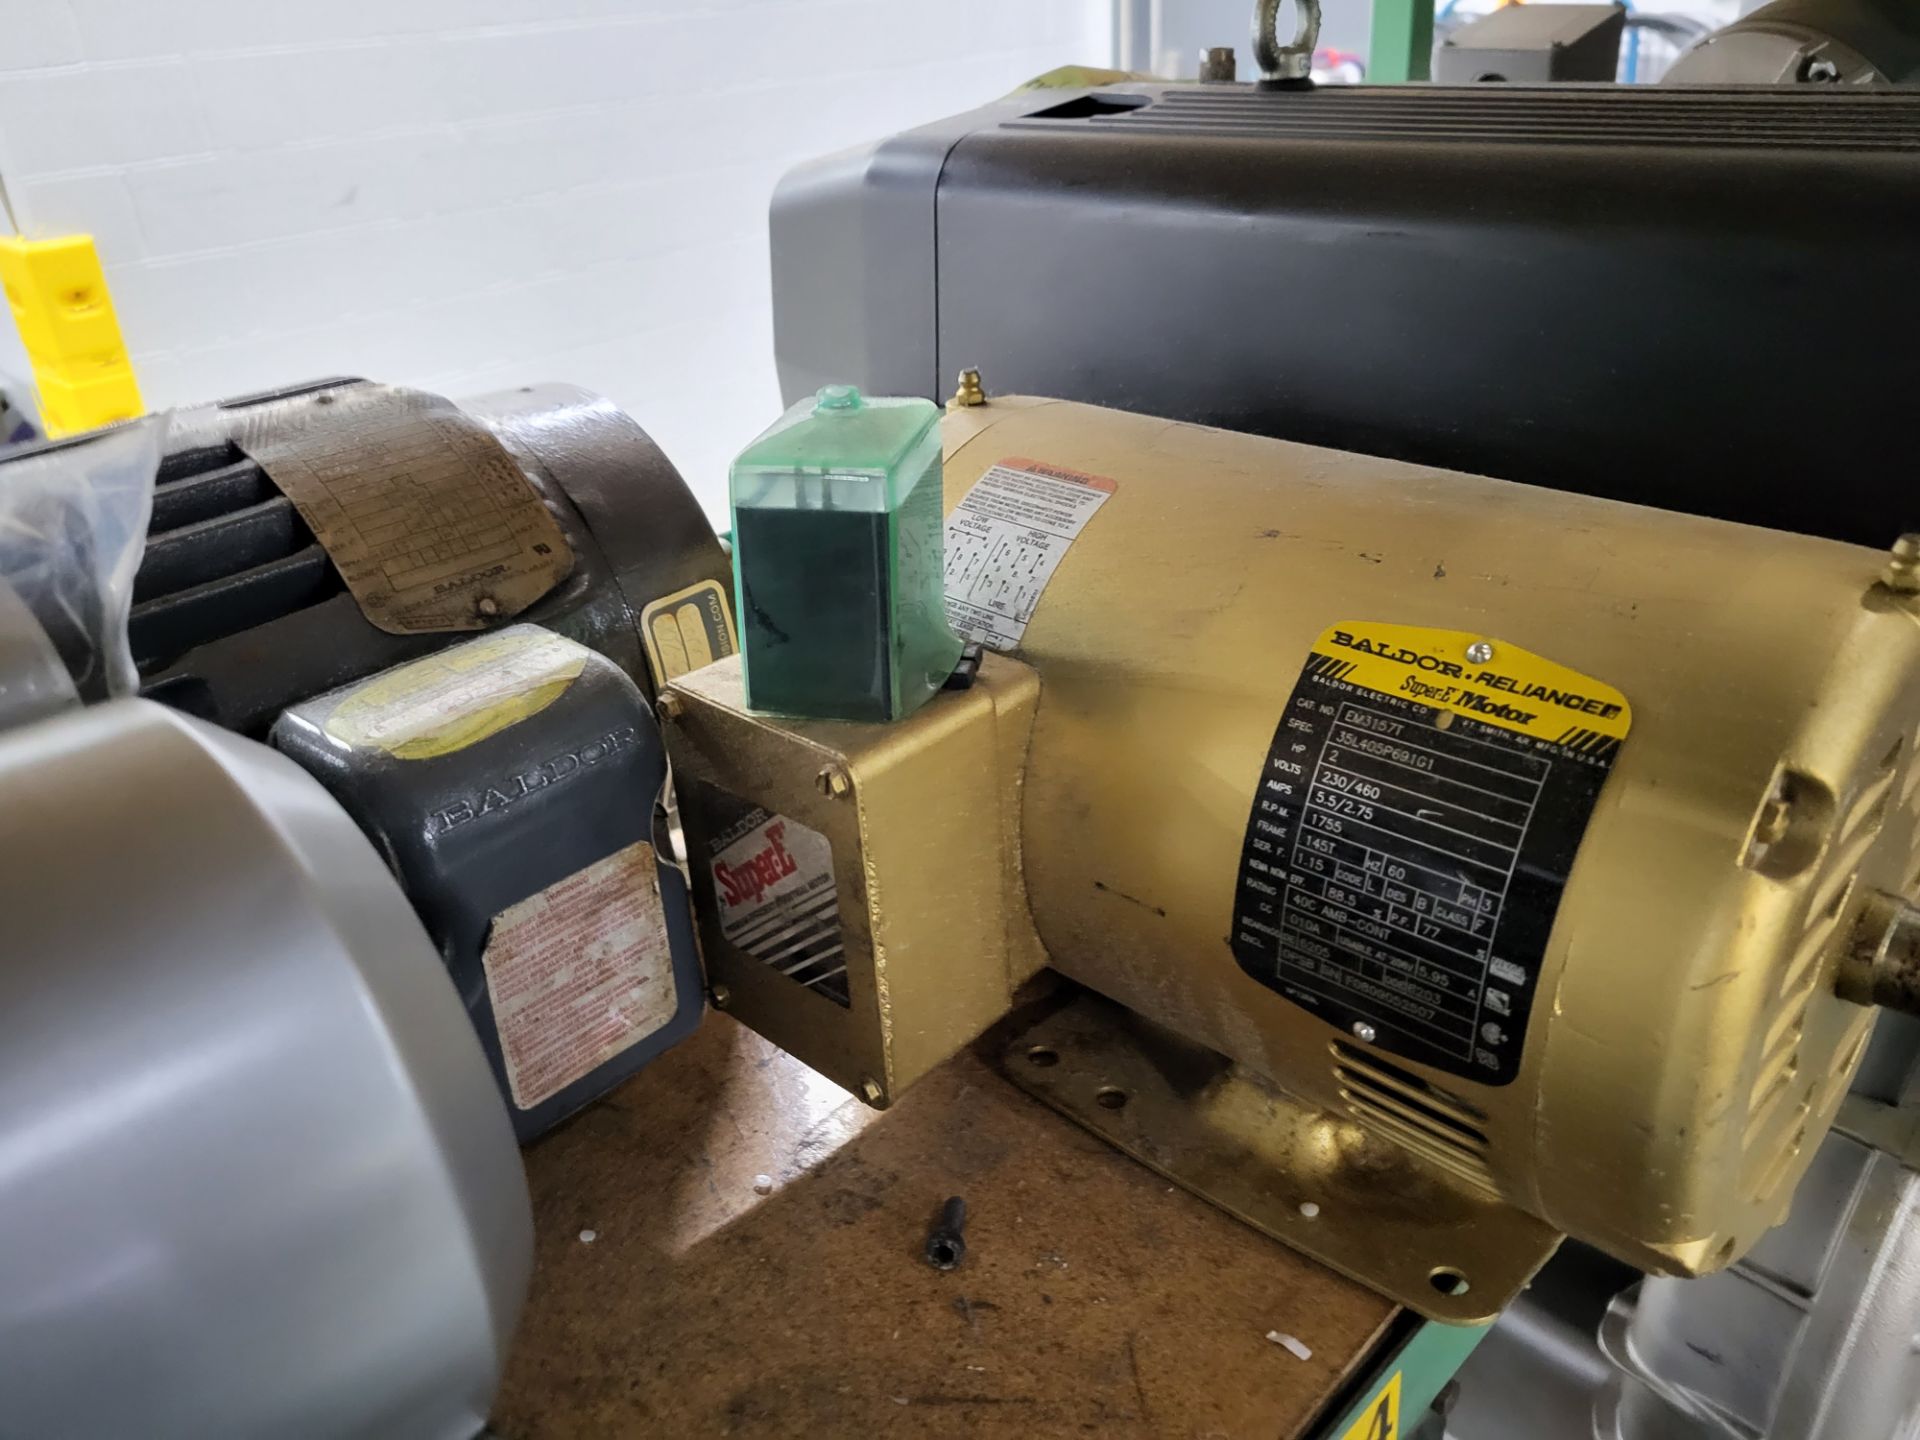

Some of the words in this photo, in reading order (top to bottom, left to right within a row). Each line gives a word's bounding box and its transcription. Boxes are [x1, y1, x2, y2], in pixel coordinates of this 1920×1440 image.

[960, 518, 993, 534] VOLTAGE
[971, 514, 990, 523] LOW
[1027, 530, 1048, 541] HIGH
[1016, 535, 1050, 551] VOLTAGE
[1330, 630, 1464, 679] BALDOR
[1312, 675, 1353, 692] BALDOR
[1356, 688, 1408, 709] ELECTRIC
[1453, 690, 1538, 725] Motor
[1287, 717, 1314, 735] SPEC.
[1296, 697, 1316, 711] CAT.
[1318, 704, 1336, 716] NO.
[1344, 709, 1405, 737] EM3157T
[1291, 742, 1307, 753] HP
[1328, 749, 1339, 763] 2
[434, 727, 641, 834] BALDOR
[1273, 758, 1302, 775] VOLTS
[1321, 770, 1381, 800] 230/460
[1261, 800, 1289, 818] R.P.M.
[1311, 813, 1343, 833] 1755
[1266, 779, 1293, 795] AMPS
[1315, 790, 1374, 821] 5.5/2.75
[709, 807, 769, 852] BALDOR
[1253, 837, 1272, 853] SER.
[1298, 852, 1325, 871] 1.15
[1335, 869, 1363, 887] CODE
[1367, 879, 1376, 892] L
[1386, 887, 1408, 904] DES
[1416, 896, 1428, 911] B
[1434, 906, 1469, 928] CLASS
[1473, 919, 1486, 931] F
[1256, 819, 1288, 838] FRAME
[1306, 834, 1337, 855] 145T
[1365, 860, 1382, 872] HZ
[1387, 864, 1406, 881] 60
[1481, 898, 1493, 913] 3
[1246, 876, 1278, 896] RATING
[1292, 894, 1317, 911] 40C
[1327, 886, 1357, 907] 88.5
[1422, 922, 1441, 939] 77
[1259, 901, 1273, 914] CC
[1419, 965, 1450, 987] 5.95
